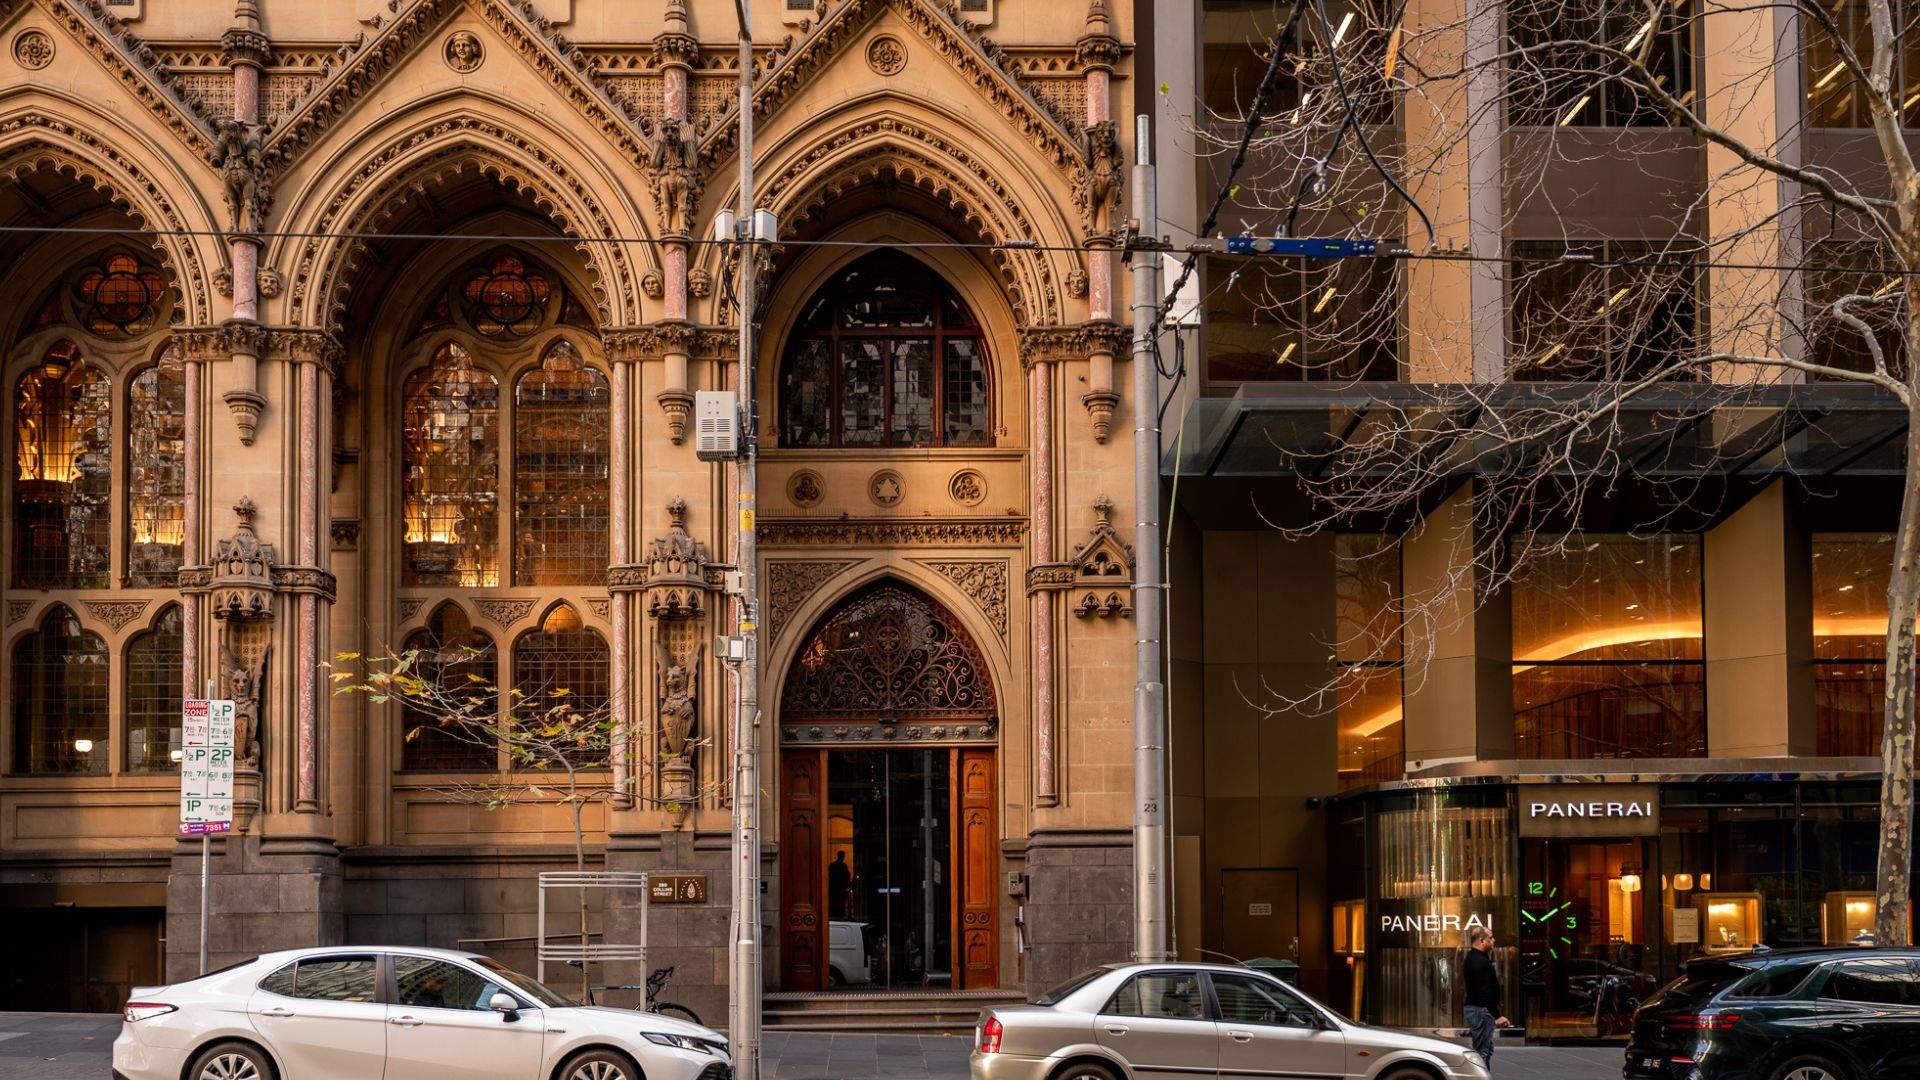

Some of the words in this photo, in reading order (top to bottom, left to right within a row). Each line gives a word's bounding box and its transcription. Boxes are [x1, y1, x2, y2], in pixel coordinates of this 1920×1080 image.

[185, 701, 208, 709] LOADING
[211, 749, 232, 761] 2P
[187, 800, 201, 812] 1P
[1144, 803, 1157, 812] 23
[1531, 802, 1651, 817] PANERAI
[1528, 882, 1543, 894] 12
[1381, 913, 1492, 931] PANERAI
[1566, 916, 1577, 929] 3
